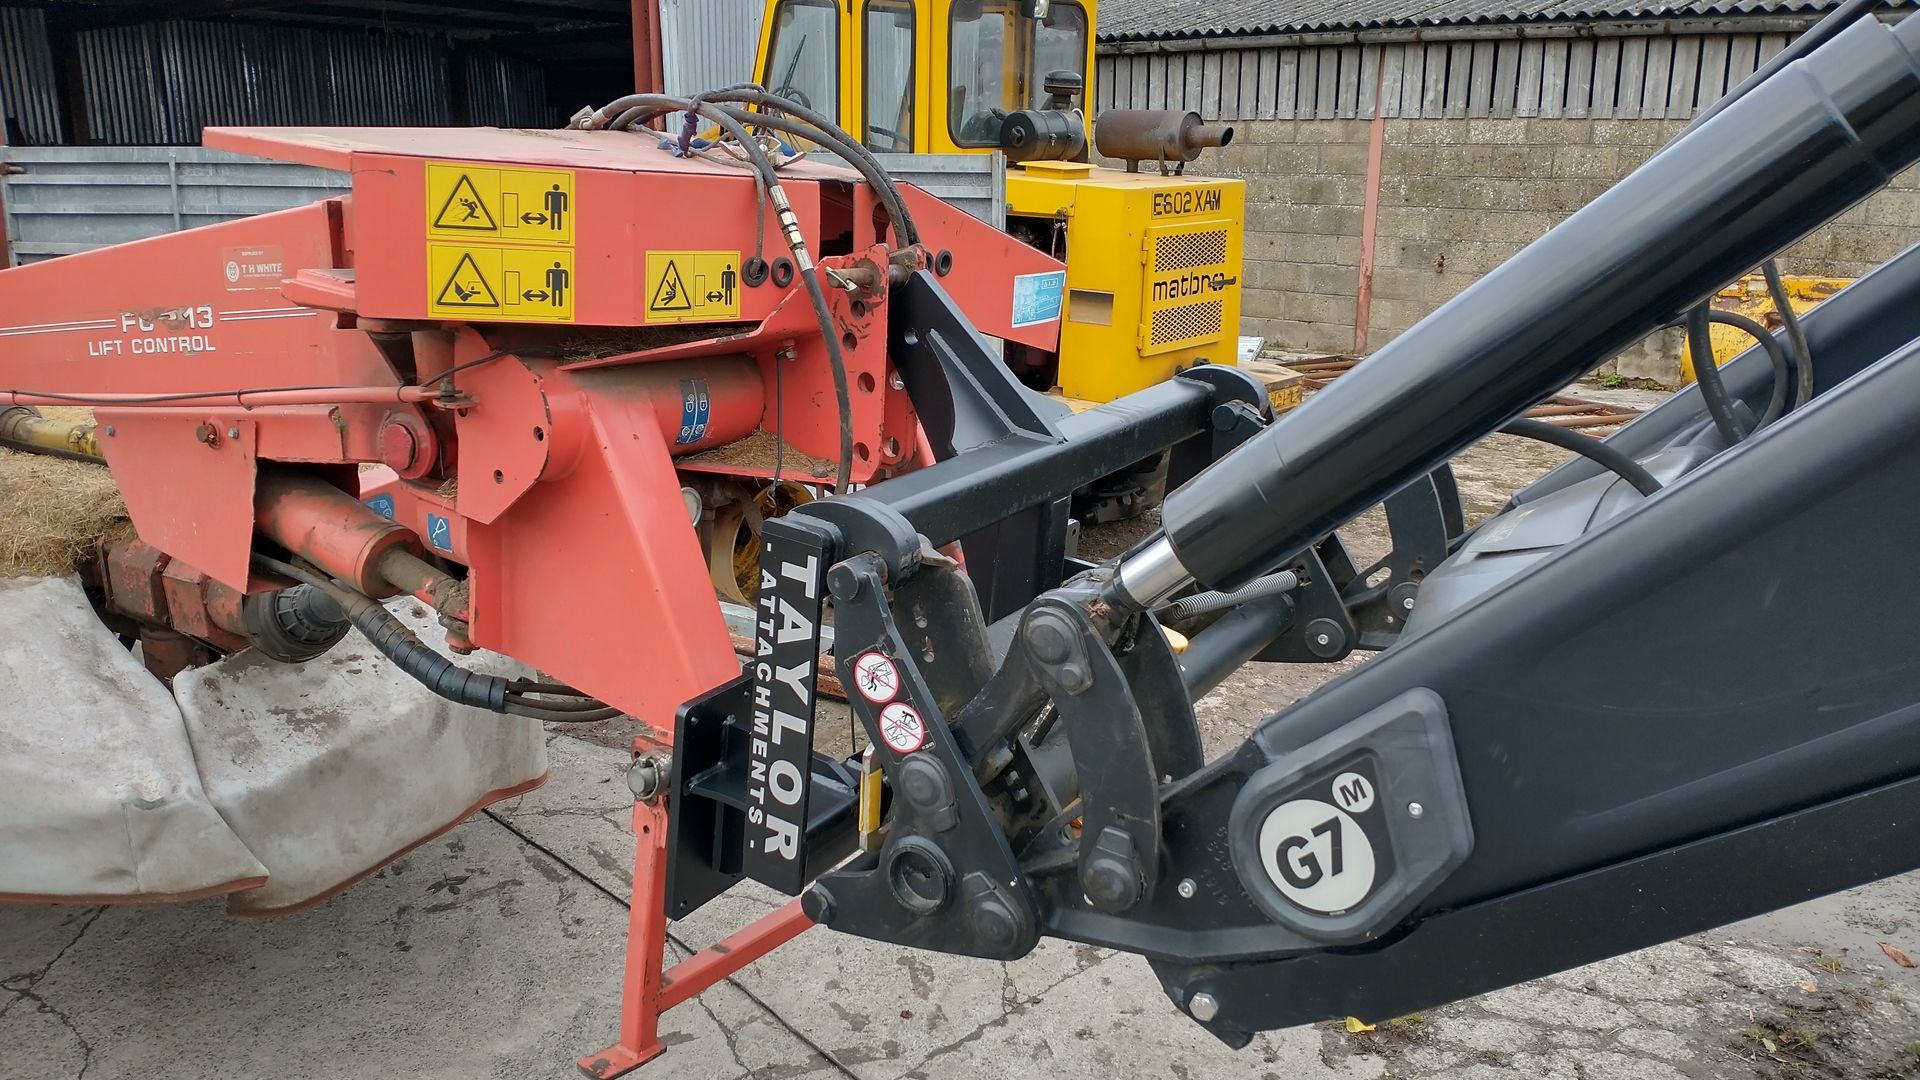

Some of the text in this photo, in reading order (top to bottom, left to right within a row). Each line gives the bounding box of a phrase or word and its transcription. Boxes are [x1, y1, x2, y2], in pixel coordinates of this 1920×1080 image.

[1153, 189, 1221, 216] E602 XAM
[241, 263, 283, 274] T H WHITE
[88, 335, 216, 356] LIFT CONTROL
[748, 568, 777, 826] ATTACHMENTS
[764, 554, 818, 861] TAYLOR
[1338, 777, 1368, 807] M
[1275, 815, 1343, 889] G7
